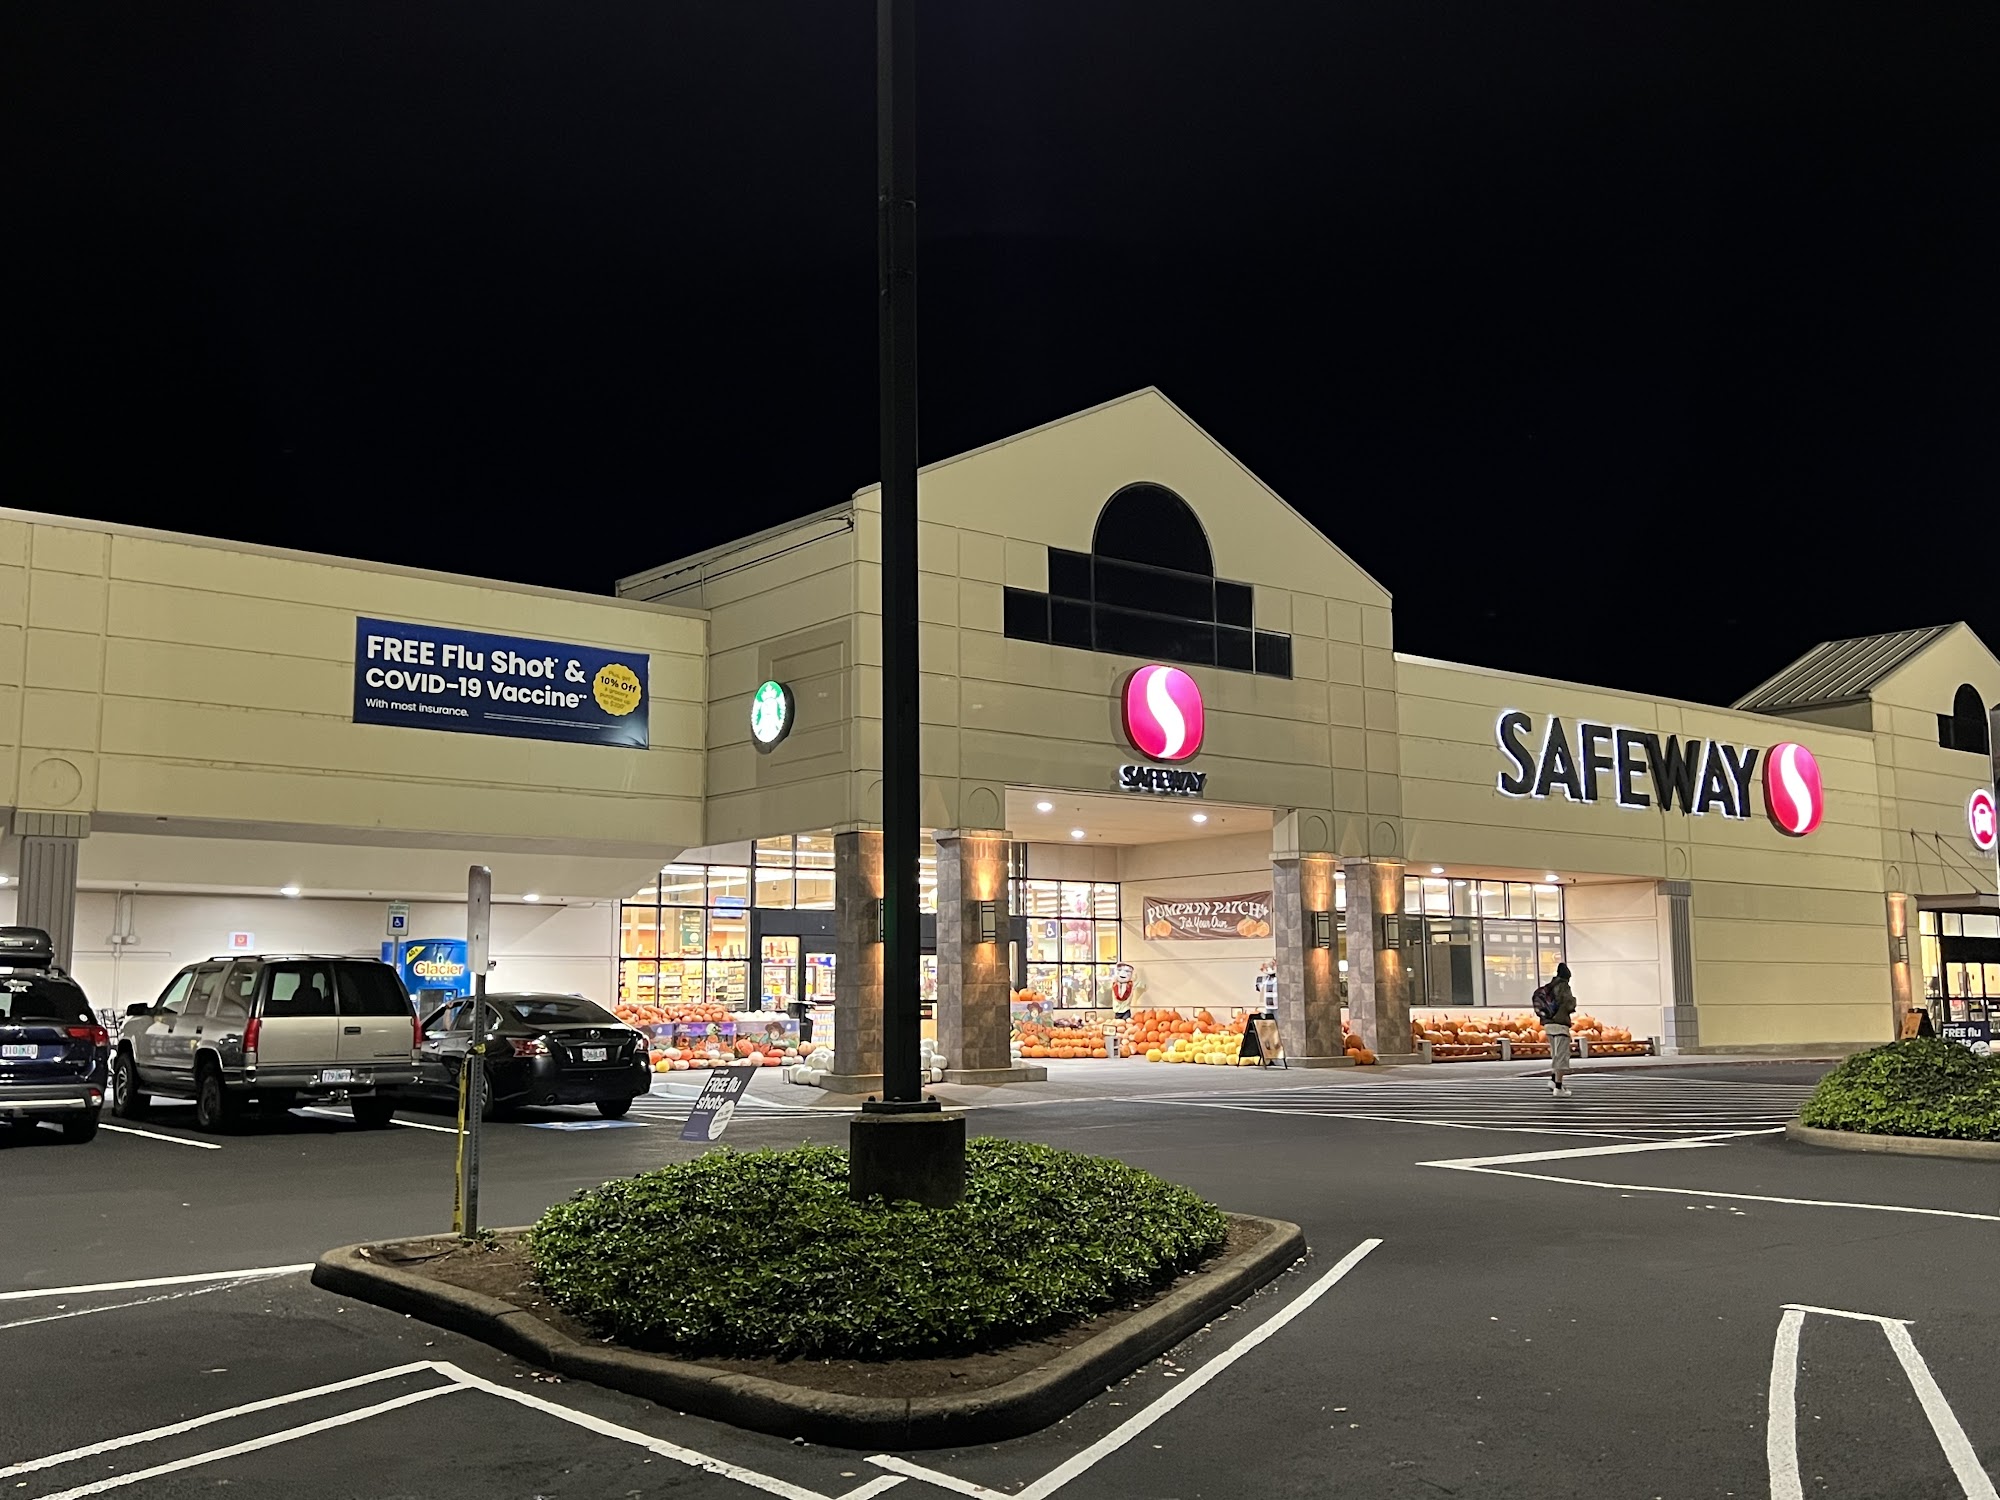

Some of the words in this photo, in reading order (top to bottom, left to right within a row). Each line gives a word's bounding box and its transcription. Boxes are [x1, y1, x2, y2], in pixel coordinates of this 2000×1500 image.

[367, 635, 435, 666] FREE
[442, 644, 484, 672] Flu
[564, 659, 587, 683] &
[365, 667, 482, 698] COVID-19
[601, 676, 619, 688] 10%
[621, 682, 637, 692] Off
[365, 697, 389, 709] With
[391, 701, 417, 712] most
[1495, 708, 1760, 821] SAFEWAY
[1118, 764, 1207, 794] SAFEWAY
[1146, 901, 1211, 924] PUMPKIN
[413, 960, 465, 977] Glacier
[1942, 1027, 1967, 1039] FREE
[1967, 1026, 1982, 1038] flu
[704, 1077, 731, 1093] FREE
[725, 1076, 742, 1093] flu
[696, 1093, 725, 1110] shots
